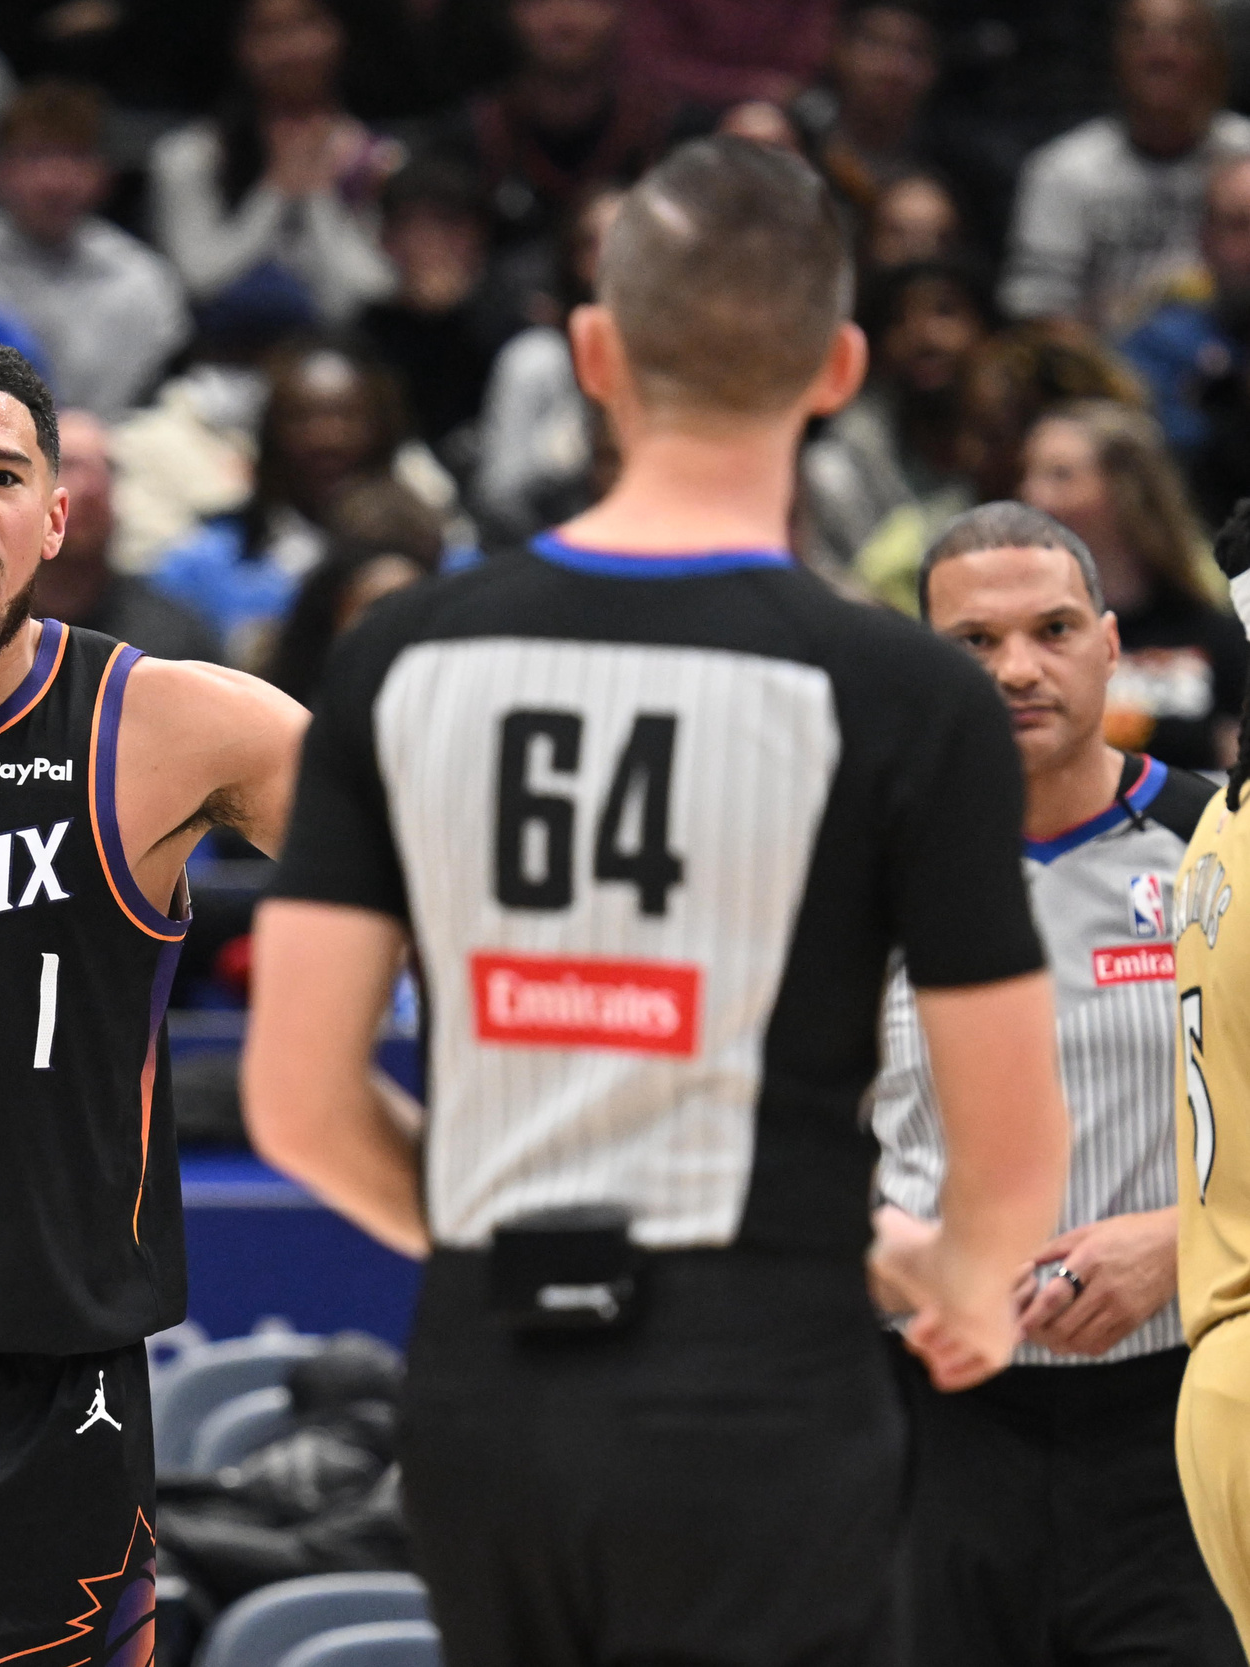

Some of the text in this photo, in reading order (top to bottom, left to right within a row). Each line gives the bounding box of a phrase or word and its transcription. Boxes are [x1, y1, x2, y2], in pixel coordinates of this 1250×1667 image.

[494, 708, 684, 918] 64
[33, 952, 60, 1070] 1
[486, 967, 681, 1038] Emirates
